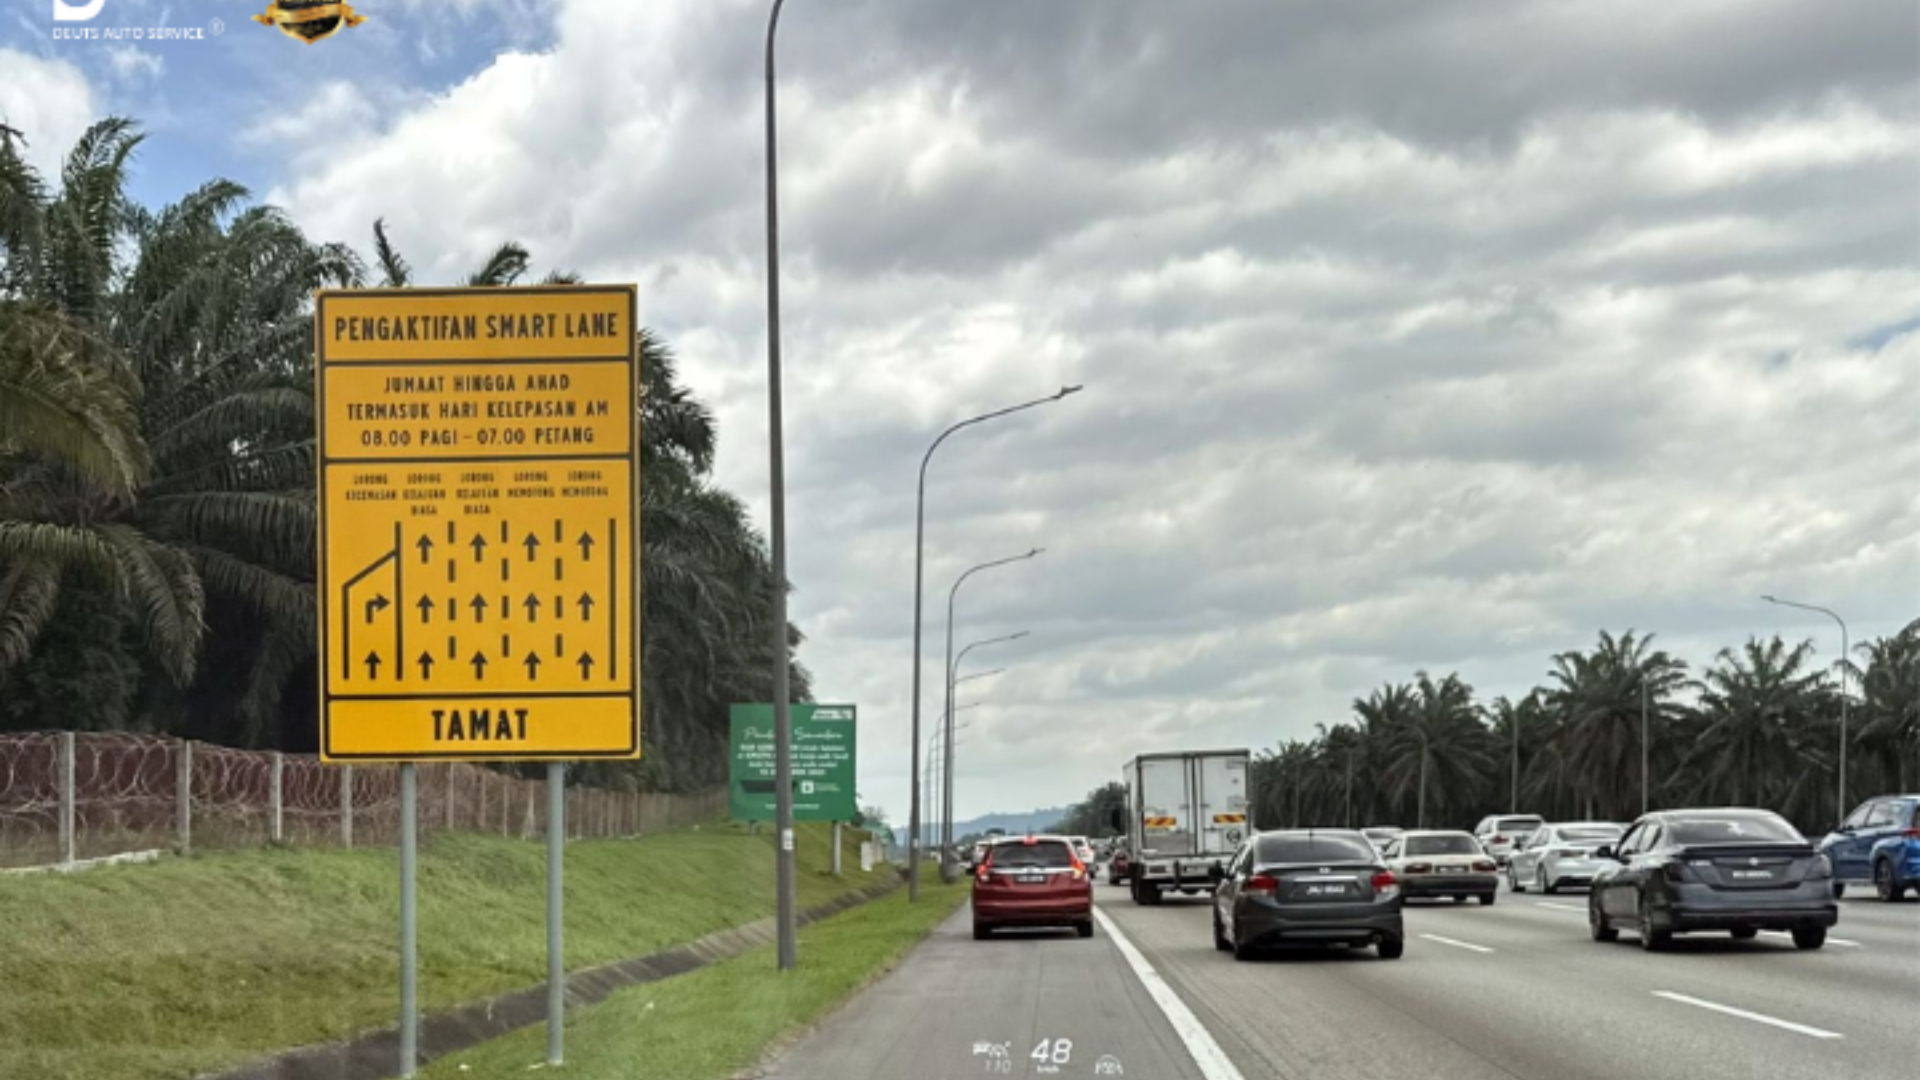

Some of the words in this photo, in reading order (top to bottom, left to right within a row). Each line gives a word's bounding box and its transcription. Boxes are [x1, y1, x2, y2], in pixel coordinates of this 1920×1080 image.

[335, 314, 476, 341] PENGAKTIFAN
[486, 314, 558, 339] SMART
[565, 312, 618, 338] LANE
[384, 376, 445, 393] JUMAAT
[453, 375, 516, 392] HINGGA
[525, 374, 570, 391] AHAD
[347, 403, 430, 420] TERMASUK
[439, 402, 478, 419] HARI
[487, 401, 576, 418] KELEPASAN
[586, 400, 609, 416] AM
[361, 429, 411, 447] 08.00
[420, 429, 458, 445] PAGI
[476, 428, 525, 445] 07.00
[535, 427, 594, 444] PETANG
[431, 708, 528, 741] TAMAT
[1030, 1038, 1073, 1064] 48
